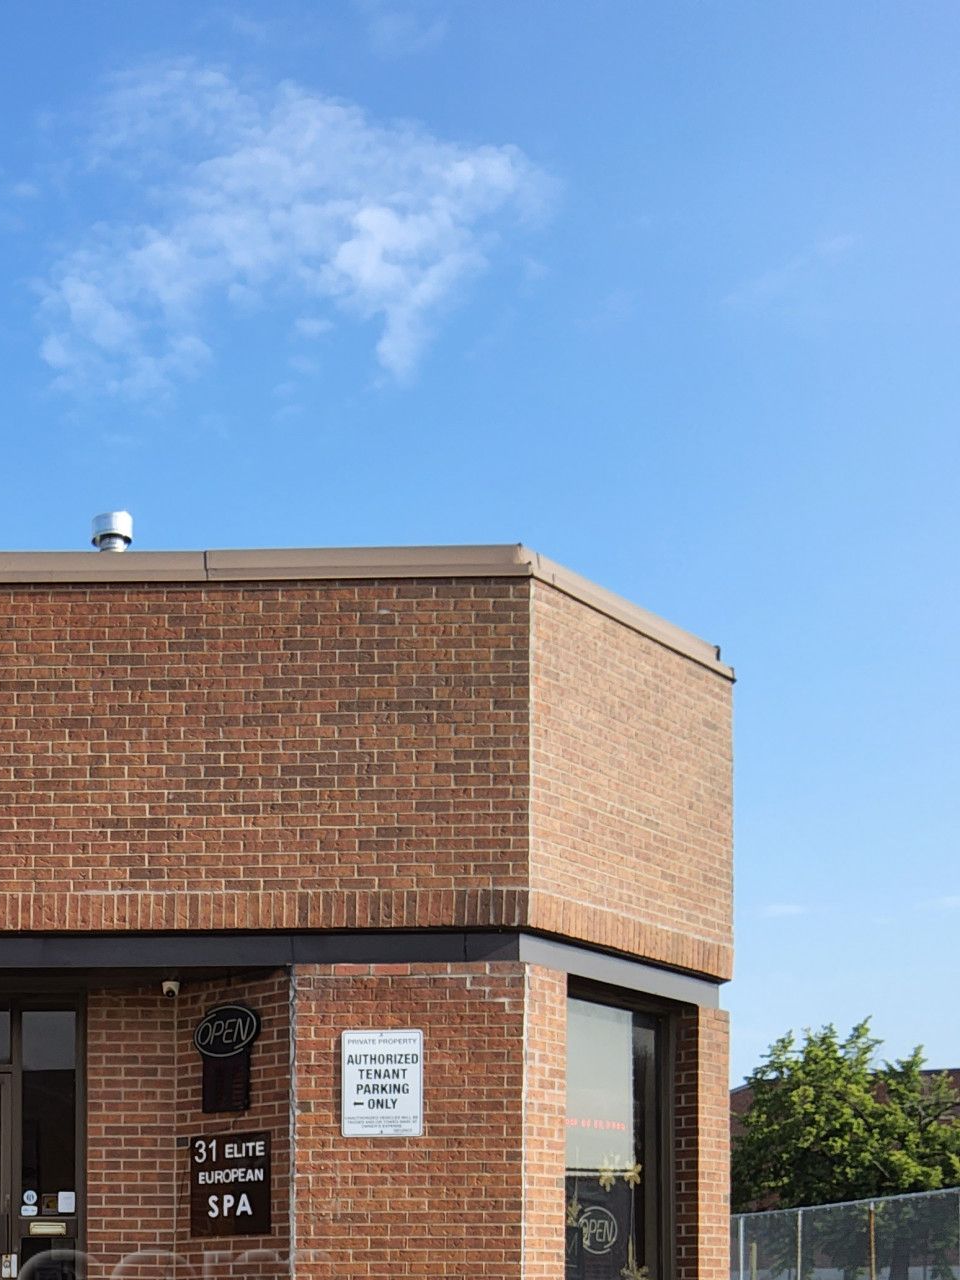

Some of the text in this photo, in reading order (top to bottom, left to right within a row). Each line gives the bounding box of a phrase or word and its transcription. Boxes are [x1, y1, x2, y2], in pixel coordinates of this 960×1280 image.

[197, 1017, 251, 1046] OPEN
[346, 1053, 419, 1065] AUTHORIZED
[358, 1068, 408, 1080] TENANT
[356, 1083, 410, 1095] PARKING
[367, 1098, 398, 1110] ONLY
[194, 1139, 266, 1163] 31 ELITE
[198, 1168, 264, 1185] EUROPEAN
[207, 1193, 253, 1218] SPA
